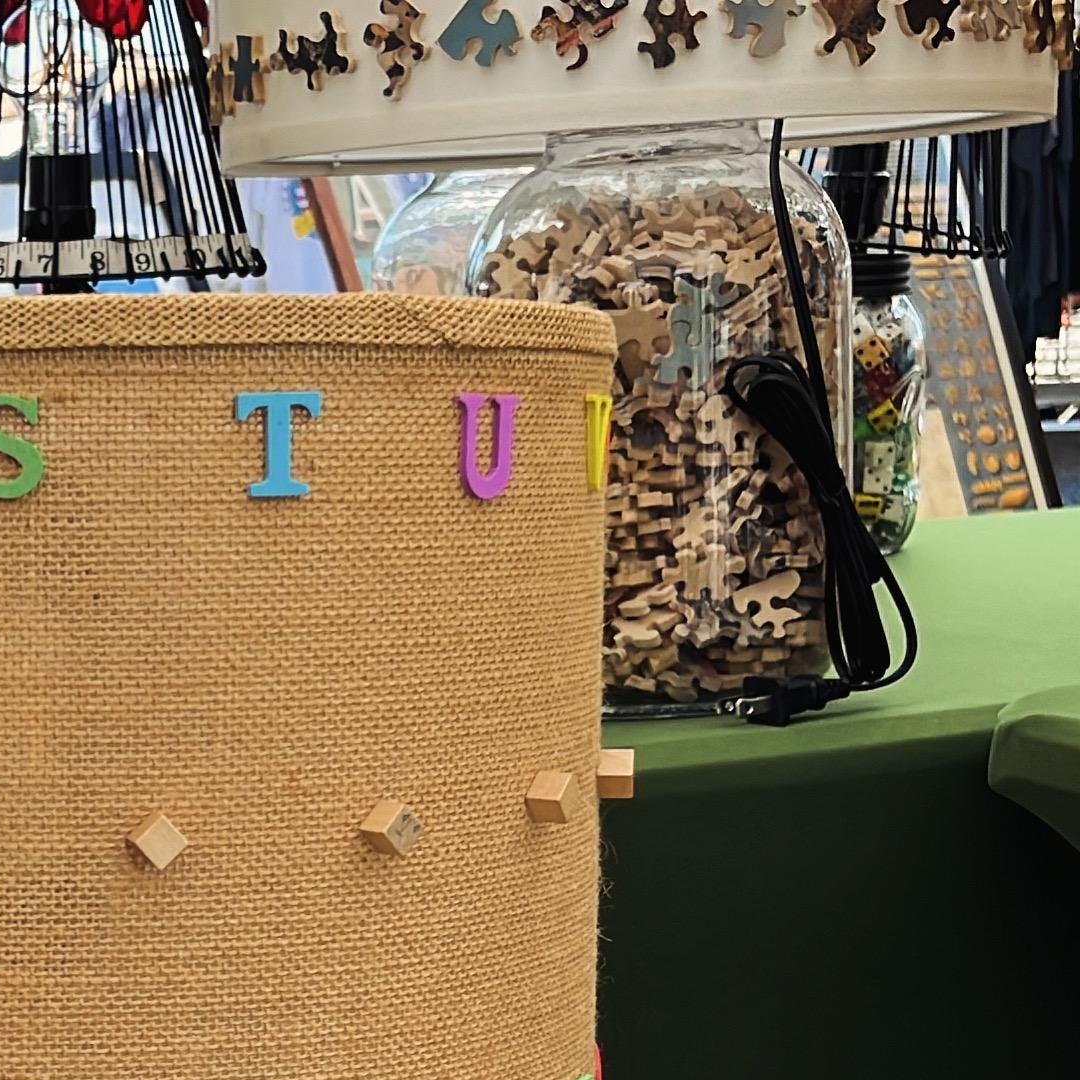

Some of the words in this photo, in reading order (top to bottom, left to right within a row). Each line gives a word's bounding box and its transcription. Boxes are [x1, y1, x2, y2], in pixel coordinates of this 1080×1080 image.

[37, 255, 53, 273] 7
[91, 251, 106, 271] 8
[136, 253, 151, 270] 9
[236, 391, 321, 498] T
[458, 393, 519, 500] U
